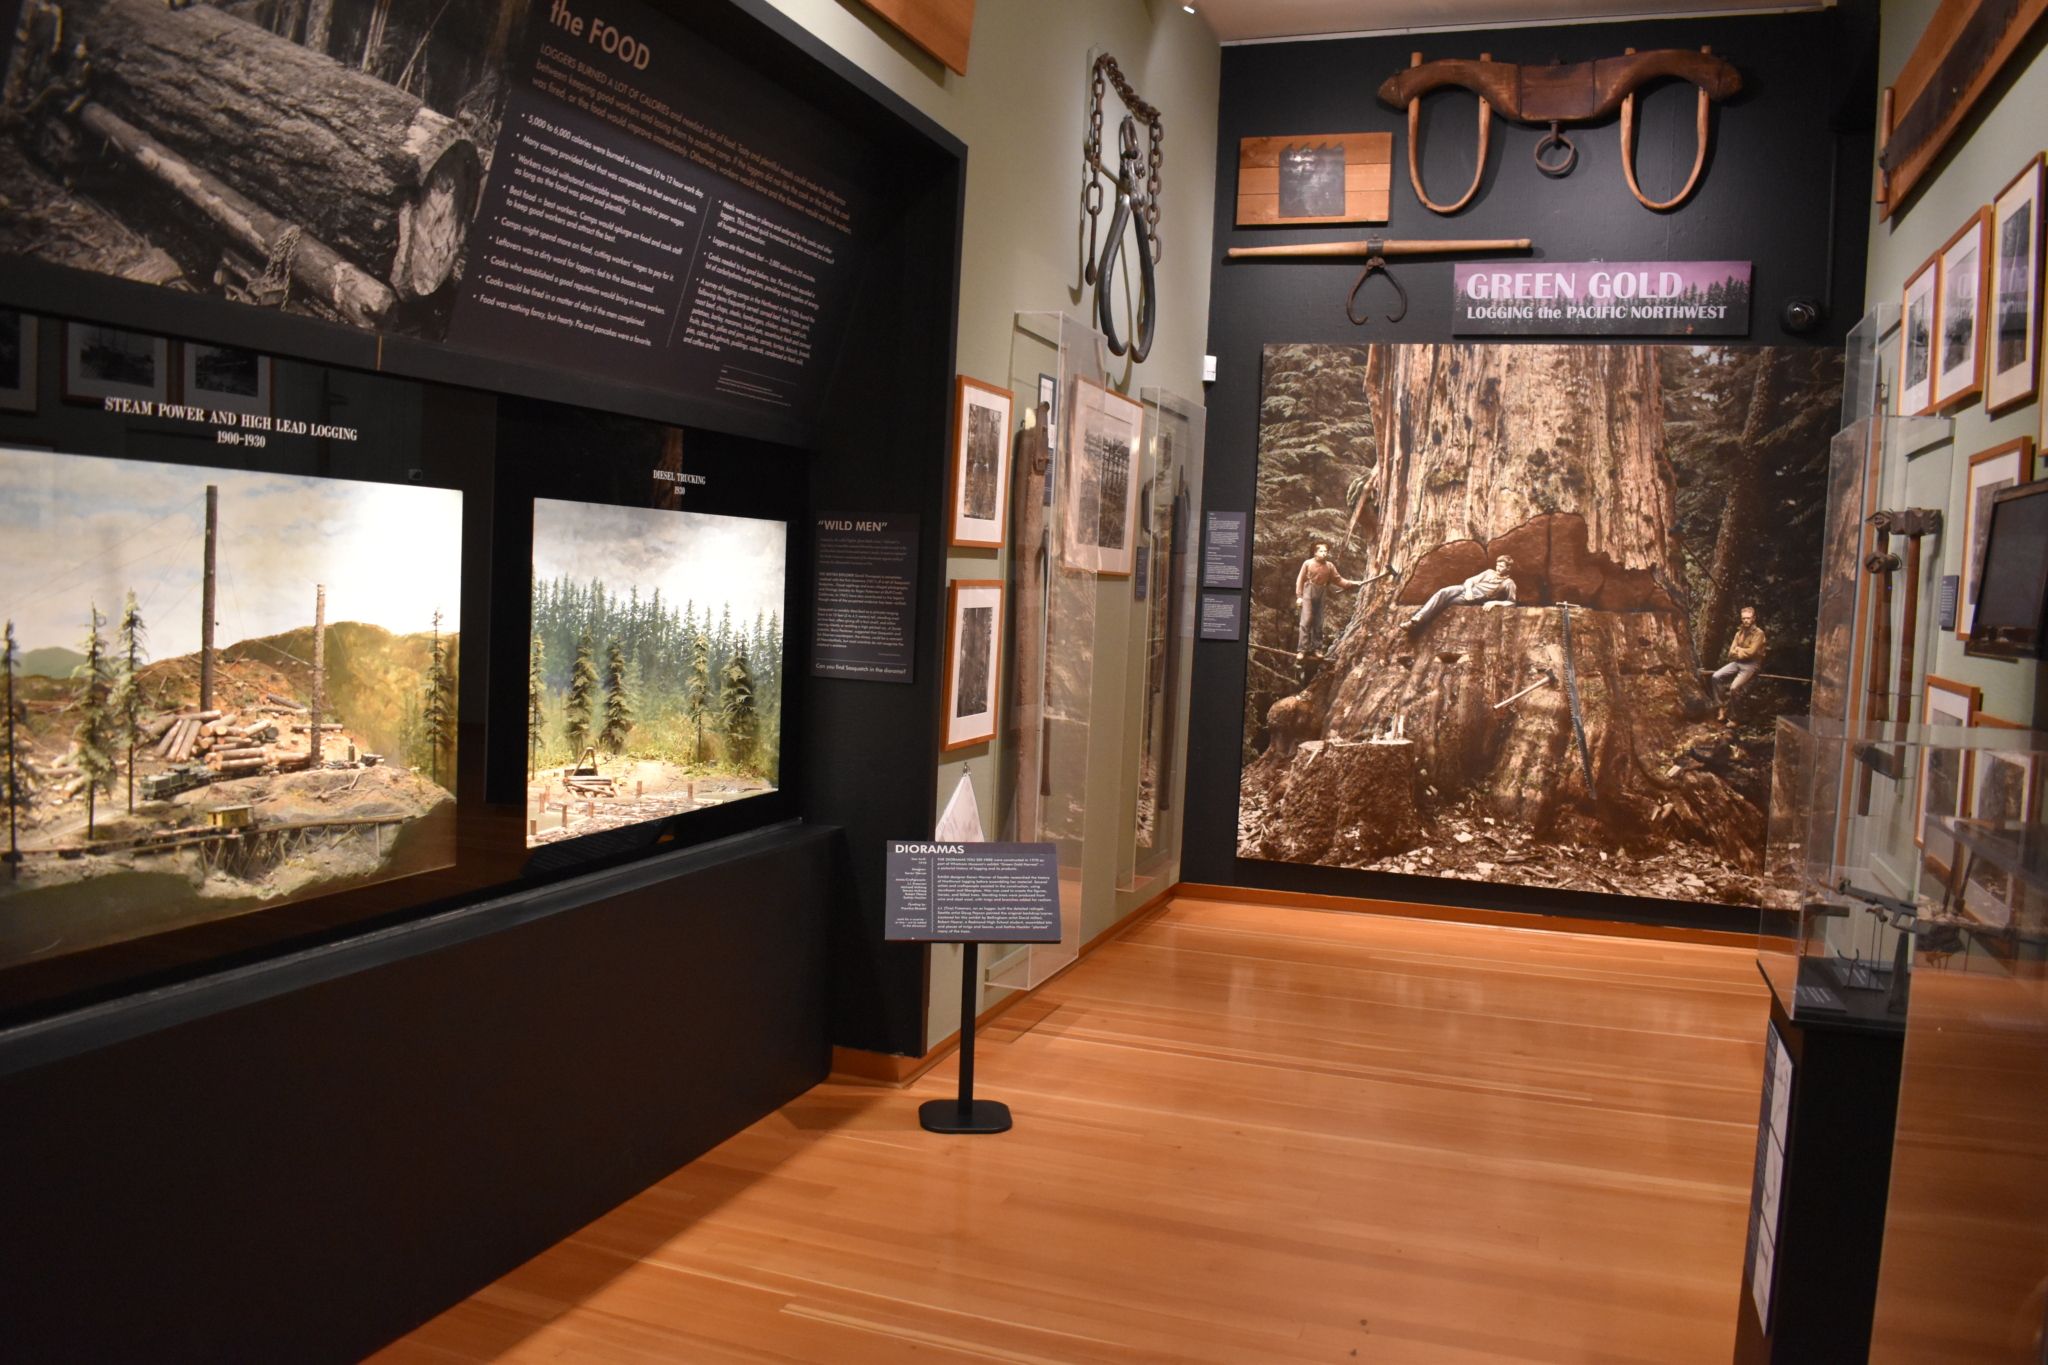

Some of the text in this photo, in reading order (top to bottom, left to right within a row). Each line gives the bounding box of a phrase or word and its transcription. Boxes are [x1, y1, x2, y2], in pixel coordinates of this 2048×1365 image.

[550, 0, 650, 70] the FOOD
[540, 43, 669, 116] LOGGERS BURNED A LOT OF CALORIES
[523, 135, 539, 148] Many
[540, 144, 558, 155] camps
[558, 151, 583, 165] provided
[583, 159, 596, 171] food
[596, 165, 607, 175] that
[607, 172, 617, 180] was
[618, 176, 647, 192] comparable
[652, 189, 663, 198] that
[662, 195, 678, 205] served
[677, 199, 683, 207] in
[528, 115, 546, 128] 5,000
[554, 126, 571, 139] 6,000
[571, 135, 591, 148] calories
[592, 145, 606, 154] were
[605, 148, 625, 163] burned
[624, 157, 630, 165] in
[634, 163, 653, 175] normal
[653, 169, 660, 178] 10
[666, 175, 673, 184] 12
[672, 178, 684, 188] hour
[683, 185, 695, 193] work
[518, 154, 541, 170] Workers
[542, 166, 558, 176] could
[558, 172, 585, 186] withstand
[584, 183, 610, 197] miserable
[610, 193, 630, 206] weather,
[641, 205, 659, 216] and/or
[658, 212, 670, 220] poor
[670, 217, 684, 226] wages
[522, 169, 536, 182] long
[544, 178, 554, 187] the
[554, 181, 568, 193] food
[568, 189, 579, 197] was
[579, 193, 594, 202] good
[593, 198, 605, 207] and
[509, 185, 522, 196] Best
[522, 190, 537, 202] food
[543, 198, 556, 208] best
[579, 211, 597, 224] Camps
[598, 220, 614, 230] would
[614, 226, 632, 237] splurge
[639, 233, 652, 244] food
[650, 239, 661, 247] and
[660, 243, 672, 251] cook
[671, 247, 683, 255] staff
[495, 236, 521, 251] Leftovers
[522, 247, 533, 255] was
[539, 250, 552, 262] dirty
[553, 257, 567, 265] word
[567, 258, 575, 267] for
[596, 268, 606, 277] fed
[611, 273, 620, 282] the
[620, 276, 636, 287] bosses
[501, 217, 521, 230] Camps
[522, 226, 539, 236] might
[539, 232, 557, 242] spend
[557, 237, 571, 247] more
[580, 243, 593, 255] food,
[594, 250, 611, 262] cutting
[632, 263, 647, 272] wages
[652, 270, 662, 278] pay
[490, 255, 508, 268] Cooks
[510, 262, 522, 272] who
[522, 267, 554, 281] established
[558, 278, 574, 287] good
[573, 282, 599, 294] reputation
[600, 291, 616, 299] would
[615, 293, 628, 305] bring
[628, 297, 634, 305] in
[634, 301, 647, 309] more
[1466, 271, 1683, 300] GREEN GOLD
[479, 294, 495, 305] Food
[508, 304, 530, 316] nothing
[530, 307, 545, 319] fancy,
[547, 312, 557, 320] but
[575, 319, 583, 328] Pie
[593, 326, 617, 337] pancakes
[1467, 305, 1728, 320] LOGGING the PACIFIC NORTHWEST
[104, 396, 358, 441] STEAM POWER AND HIGH LEAD LOGGING
[217, 430, 266, 448] 1900-1930
[653, 469, 706, 485] DIESEL TRUCKING
[895, 844, 965, 854] DIORAMAS
